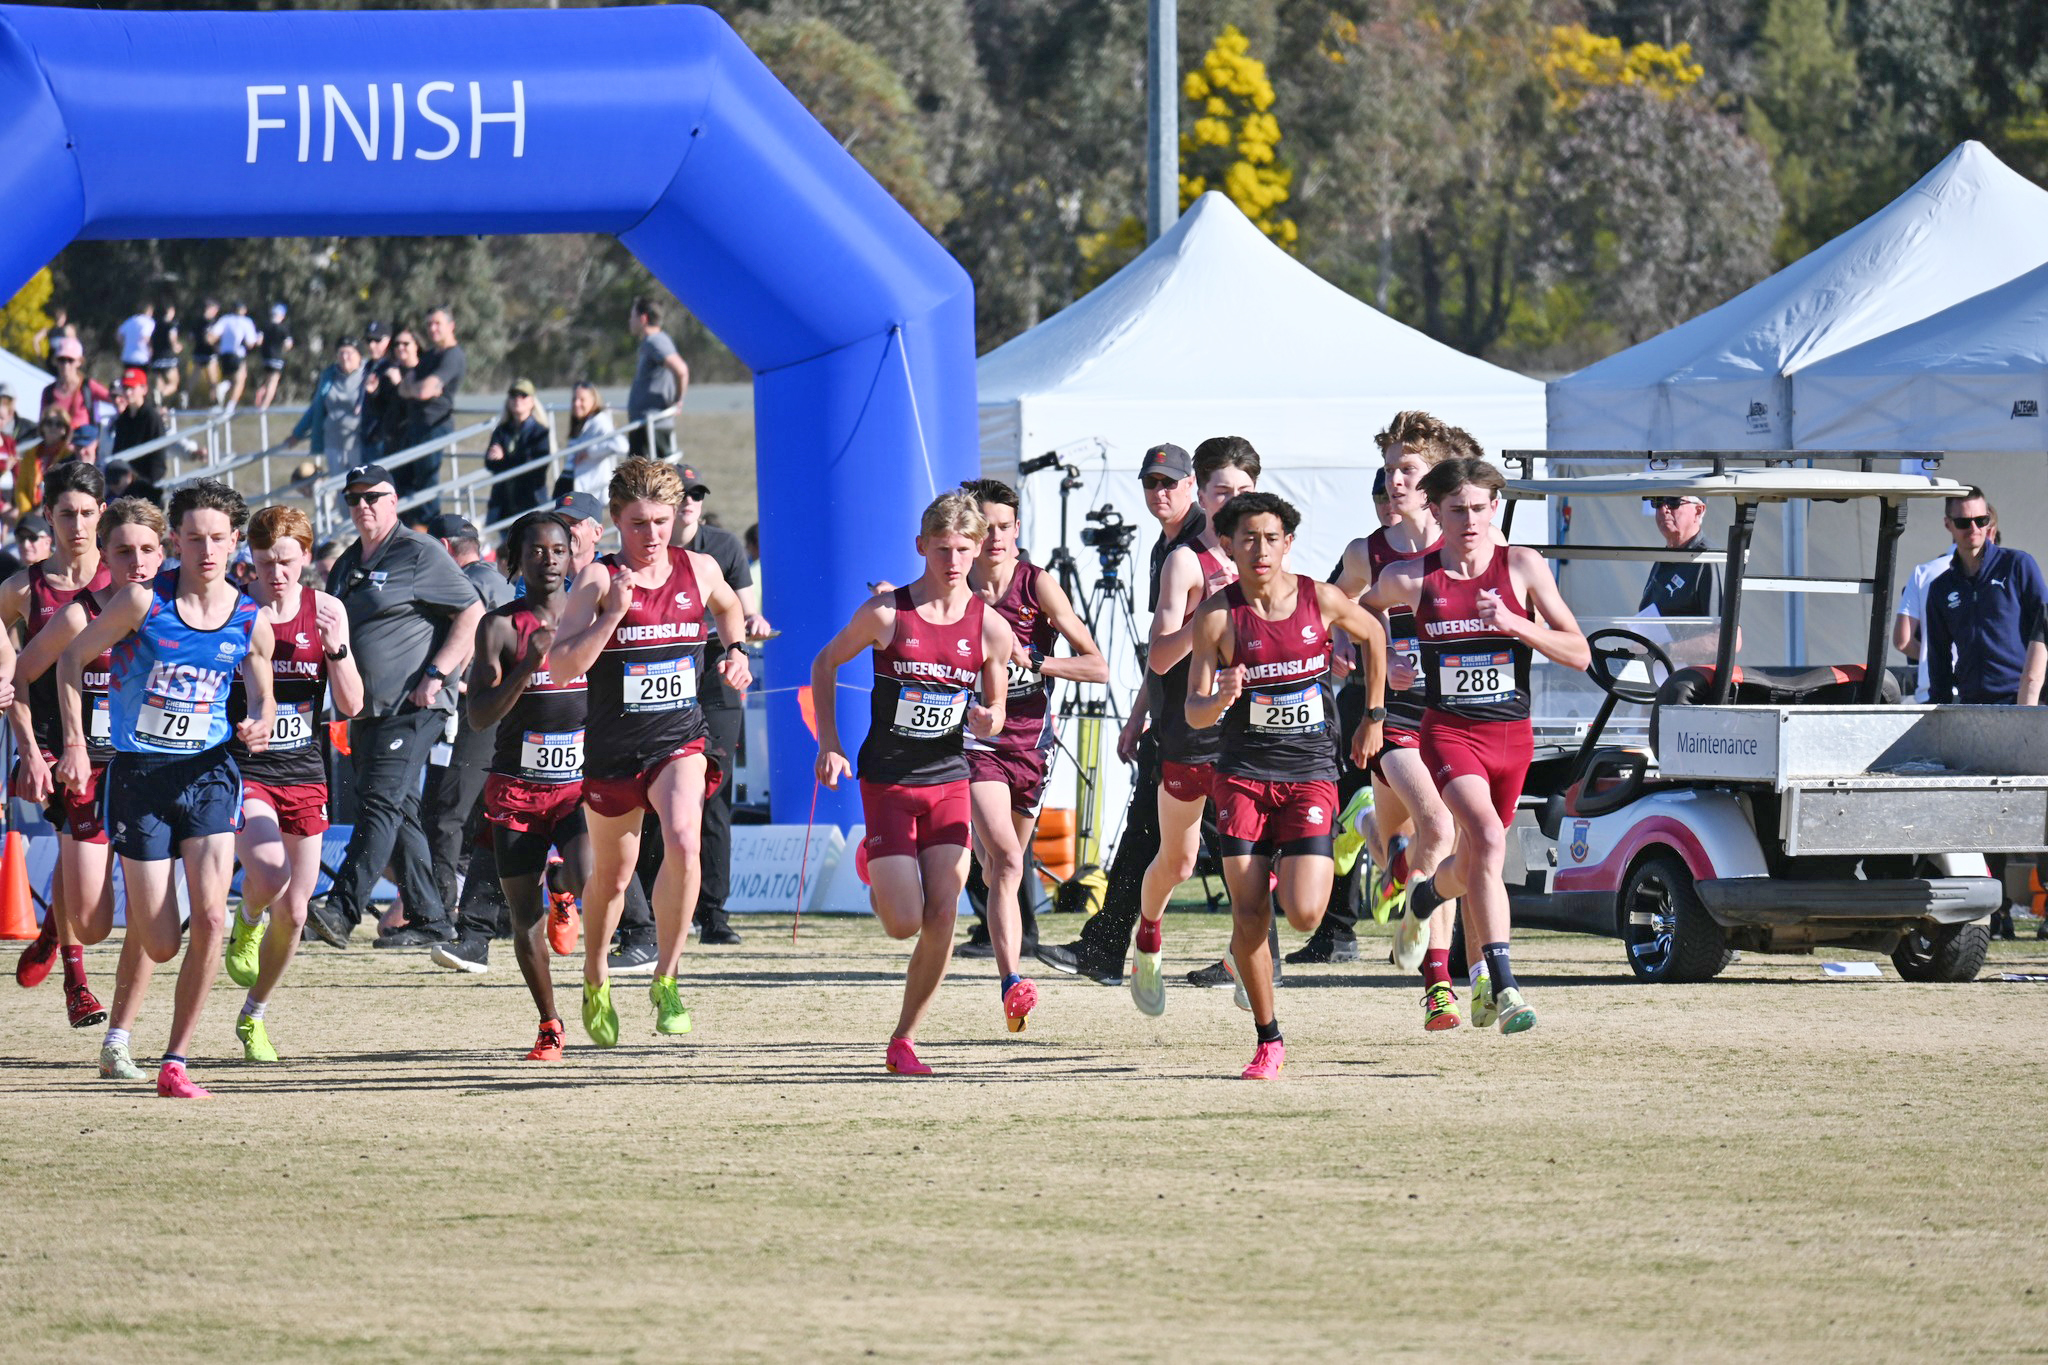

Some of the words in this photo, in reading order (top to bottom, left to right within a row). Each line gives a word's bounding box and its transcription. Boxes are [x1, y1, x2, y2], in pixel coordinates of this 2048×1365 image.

[246, 80, 525, 163] FINISH
[617, 622, 700, 644] QUEENSLAND
[1425, 619, 1500, 638] QUEENSLA
[647, 661, 676, 671] CHEMIST
[1242, 654, 1325, 683] QUEENSLAND
[1461, 654, 1491, 662] CHEMIST
[145, 660, 228, 701] NSW
[893, 661, 977, 684] QUEENSLAND
[1456, 667, 1500, 692] 288
[640, 675, 682, 700] 296
[923, 693, 952, 701] CHEMIST
[276, 703, 297, 711] EMIST
[911, 705, 954, 728] 358
[1266, 704, 1310, 726] 256
[162, 712, 190, 737] 79
[270, 716, 301, 739] 03
[1677, 731, 1758, 755] Maintenance
[536, 747, 577, 768] 305
[730, 873, 812, 898] UNDATION
